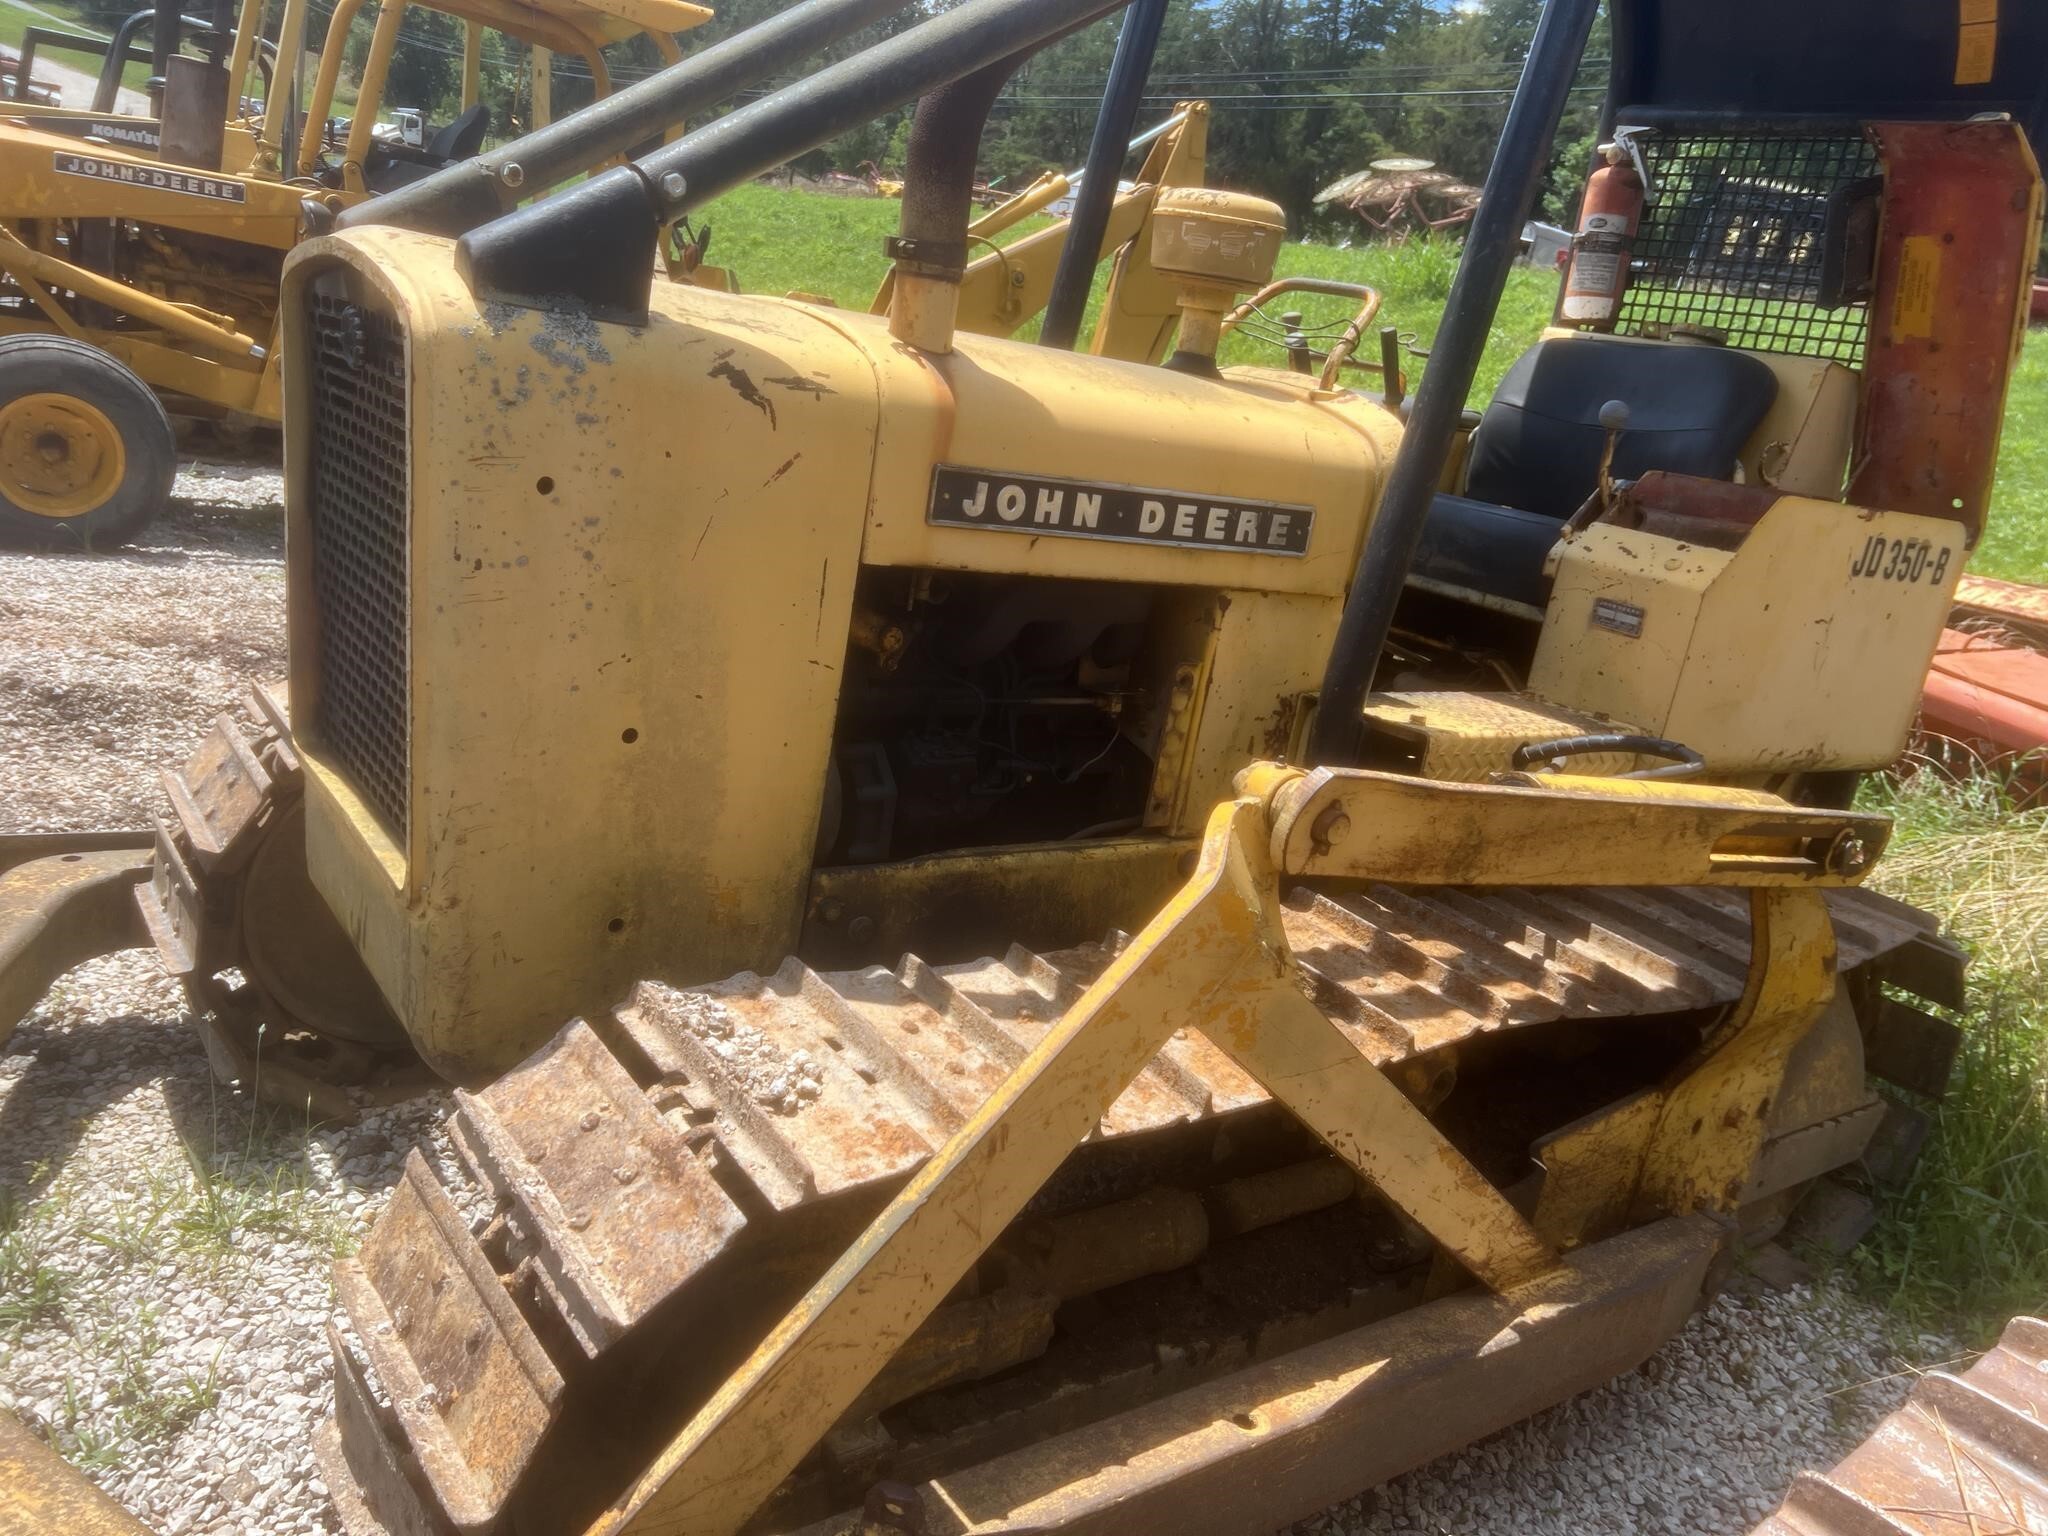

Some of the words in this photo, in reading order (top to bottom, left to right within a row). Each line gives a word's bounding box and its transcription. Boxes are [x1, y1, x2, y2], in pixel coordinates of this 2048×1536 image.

[92, 123, 160, 146] KOMATSU
[69, 158, 133, 180] JOHN
[153, 174, 233, 198] DEERE
[962, 481, 1102, 528] JOHN
[1138, 500, 1291, 545] DEERE
